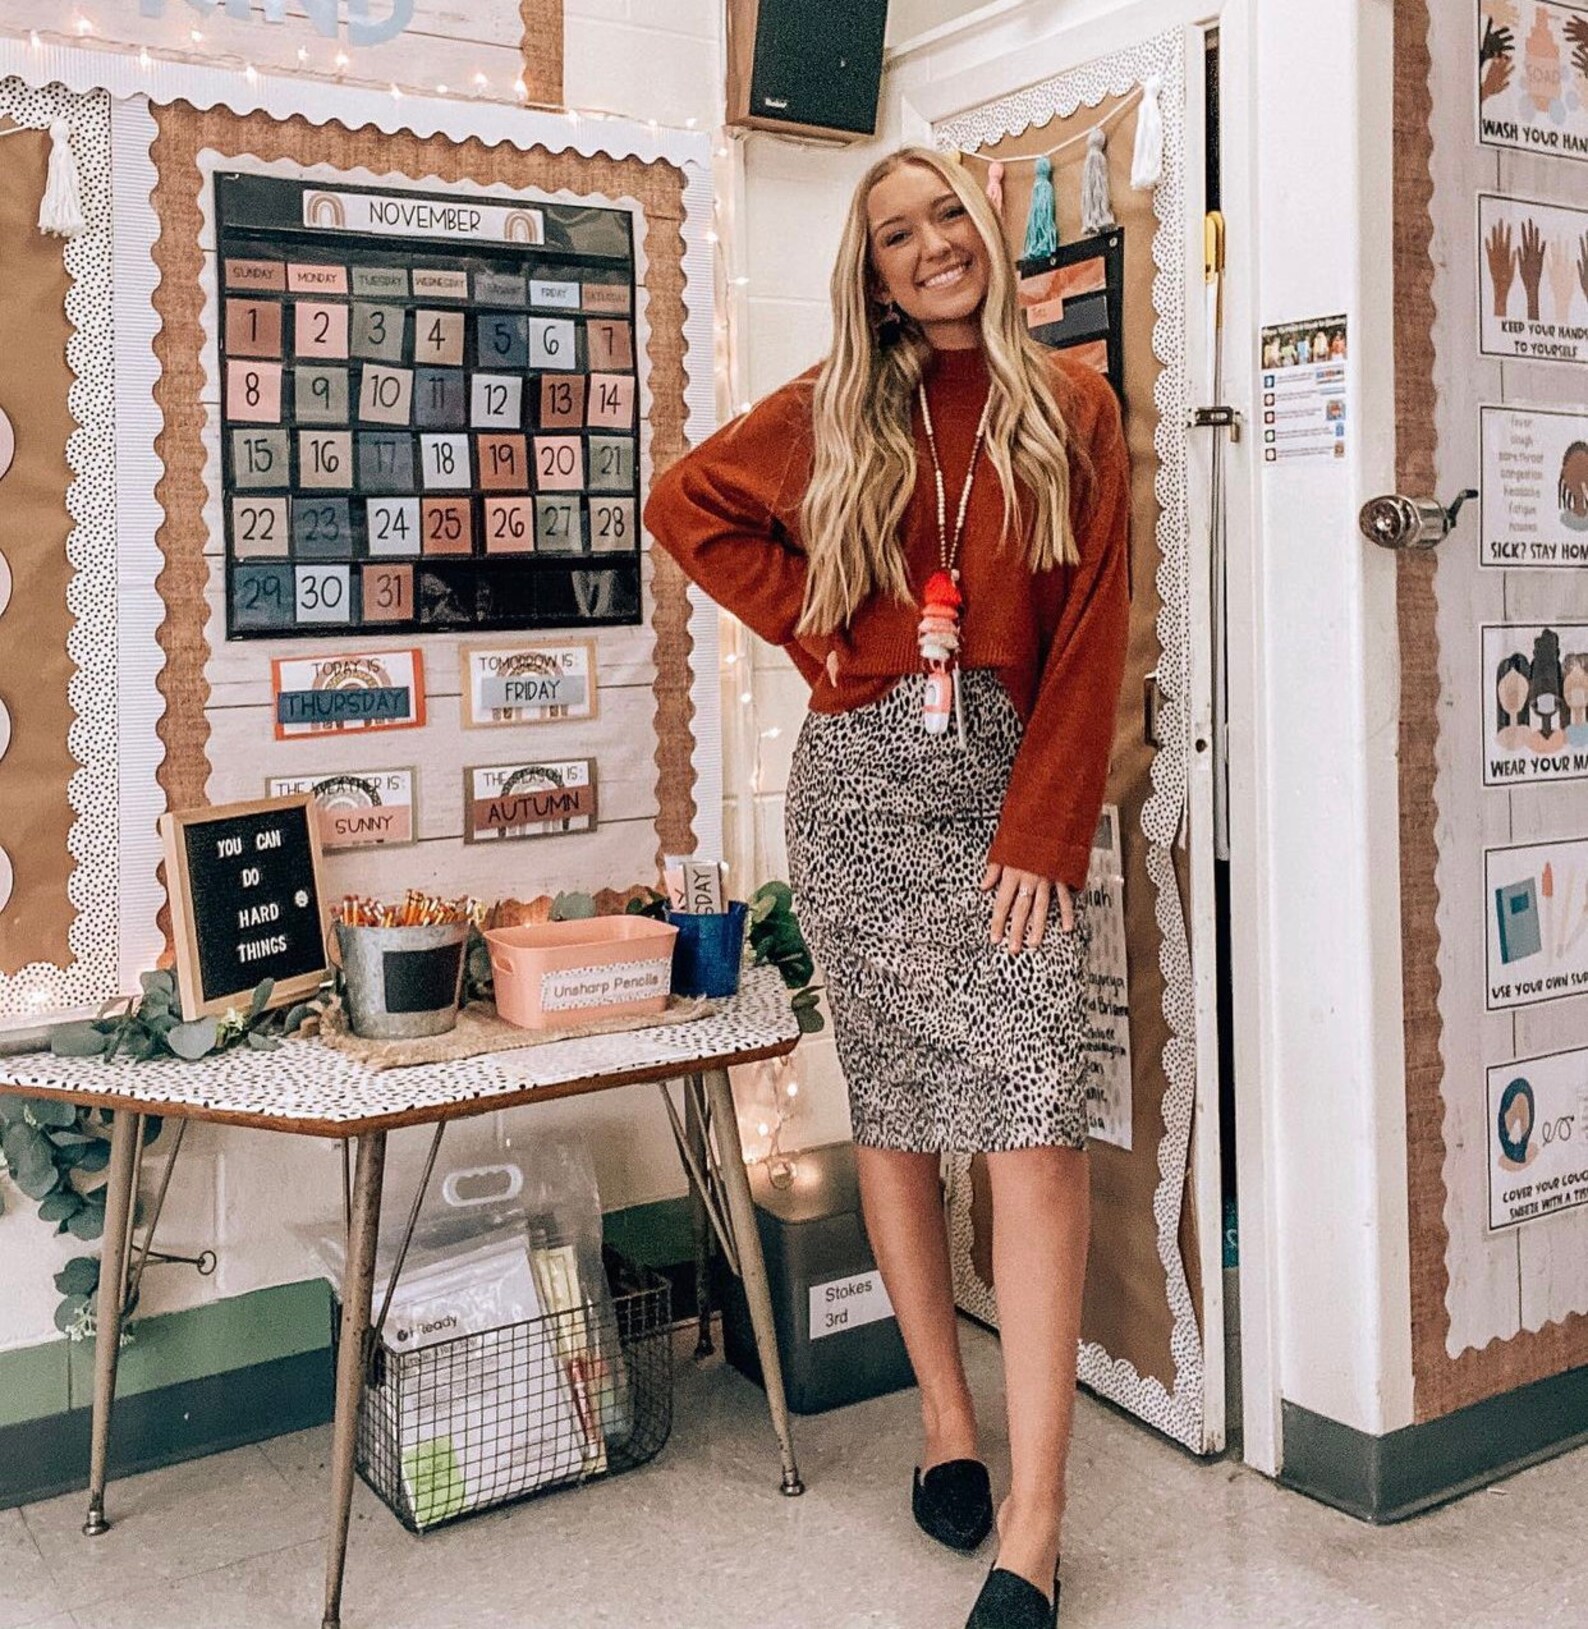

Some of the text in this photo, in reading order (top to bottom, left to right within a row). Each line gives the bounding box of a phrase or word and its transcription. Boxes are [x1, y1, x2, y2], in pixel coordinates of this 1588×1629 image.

[1483, 119, 1518, 141] WASH
[1523, 127, 1559, 147] YOUR
[369, 201, 482, 232] NOVEMBER
[233, 266, 275, 280] SUNDAY
[298, 270, 338, 284] MONDAY
[541, 287, 568, 299] FRIDAY
[248, 308, 614, 356] 1 2 3 4 5 6 7
[1501, 321, 1525, 334] KEEP
[1528, 324, 1556, 338] YOUR
[1514, 340, 1578, 358] TO YOURSELF
[245, 372, 621, 415] 8 9 10 11 12 13 14
[243, 438, 621, 475] 15 16 17 18 19 20 21
[240, 505, 626, 542] 22 23 24 25 26 27 28
[1490, 541, 1527, 559] SICK?
[1530, 542, 1557, 559] STAY
[243, 574, 407, 611] 29 30 31
[311, 659, 362, 678] TODAY
[479, 653, 558, 671] TOMORROW
[504, 679, 561, 702] FRIDAY
[286, 691, 402, 718] THURSDAY
[484, 770, 507, 787] THE
[1491, 758, 1526, 778] WEAR
[1531, 756, 1570, 774] YOUR
[276, 781, 305, 796] THE
[488, 791, 580, 824] AUTUMN
[335, 814, 394, 835] SUNNY
[217, 829, 282, 859] YOU CAN
[242, 867, 261, 888] DO
[238, 903, 280, 929] HARD
[236, 934, 288, 964] THINGS
[554, 974, 660, 999] Unsharp Pencils
[1492, 984, 1511, 999] USE
[1515, 979, 1543, 996] YOUR
[1546, 972, 1568, 990] OWN
[1503, 1185, 1533, 1203] COVER
[1535, 1177, 1560, 1194] YOUR
[1509, 1201, 1539, 1220] SNEEZE
[1541, 1194, 1563, 1211] WITH
[1565, 1192, 1571, 1203] A
[825, 1280, 873, 1303] Stokes
[825, 1308, 848, 1328] 3rd
